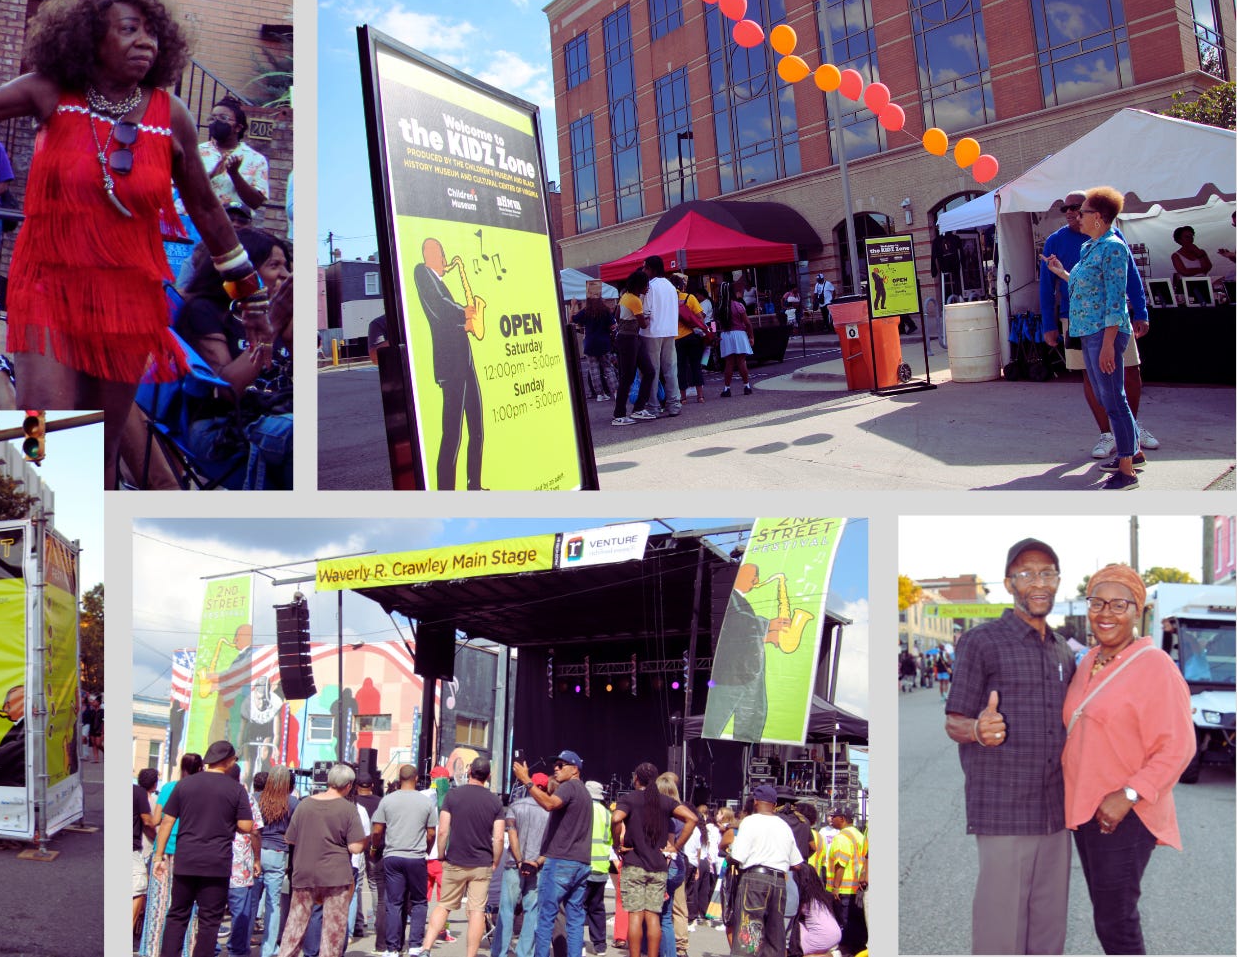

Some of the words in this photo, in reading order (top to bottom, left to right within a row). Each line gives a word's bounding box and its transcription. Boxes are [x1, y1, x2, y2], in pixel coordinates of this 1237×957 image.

[442, 112, 493, 143] Welcome
[494, 133, 505, 147] to
[398, 117, 444, 151] the
[446, 129, 496, 167] KIDZ
[495, 145, 535, 179] Zone
[406, 147, 443, 163] PRODUCED
[443, 156, 452, 165] BY
[452, 159, 465, 168] THE
[403, 158, 433, 172] HISTORY
[434, 166, 460, 179] MUSEUM
[460, 172, 473, 182] AND
[499, 312, 543, 338] OPEN
[505, 339, 543, 357] Saturday
[483, 360, 526, 381] 12:00pm
[532, 353, 562, 371] 5:00pm
[513, 377, 545, 397] Sunday
[492, 402, 528, 423] 1:00pm
[535, 390, 564, 410] 5:00pm
[589, 534, 639, 548] VENTURE
[756, 521, 835, 542] STREET
[752, 537, 829, 553] FESTIVAL
[318, 565, 370, 583] Waverly
[374, 563, 388, 578] R.
[392, 558, 448, 576] Crawley
[452, 552, 487, 570] Main
[491, 548, 537, 566] Stage
[205, 595, 246, 611] STREET
